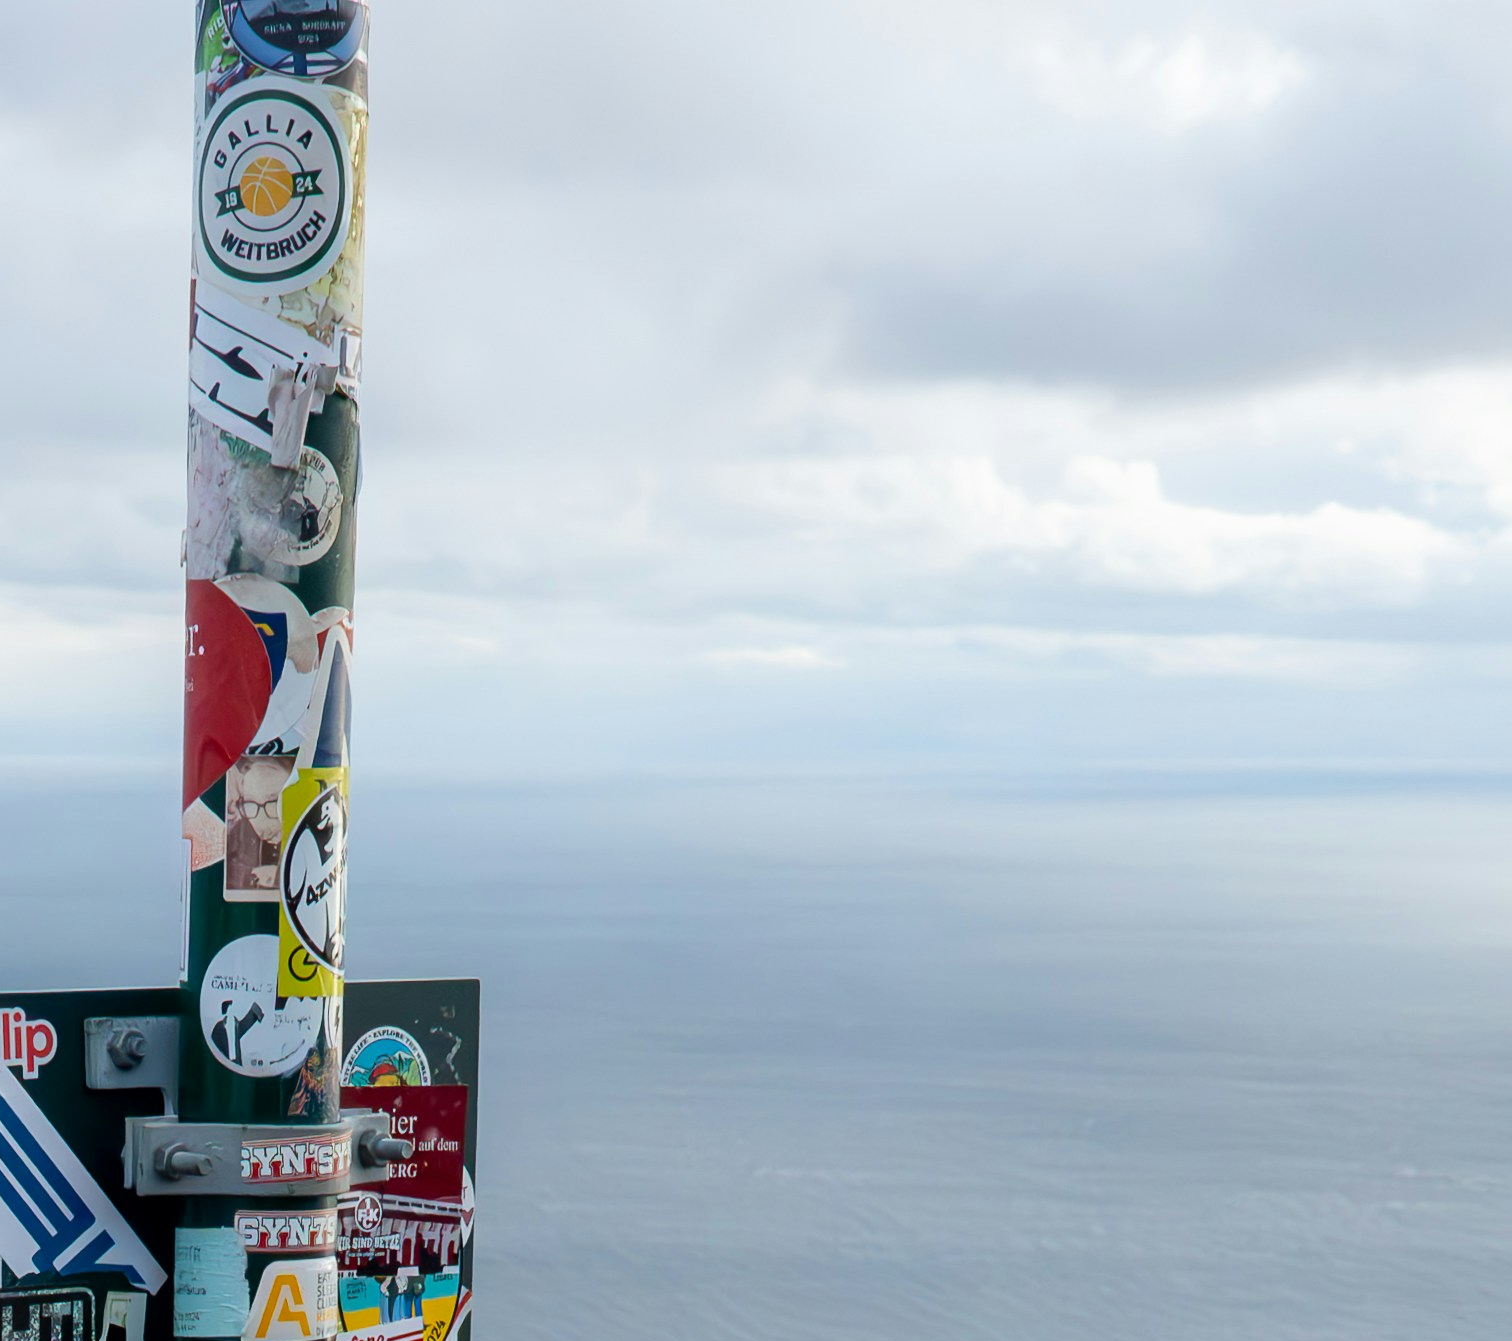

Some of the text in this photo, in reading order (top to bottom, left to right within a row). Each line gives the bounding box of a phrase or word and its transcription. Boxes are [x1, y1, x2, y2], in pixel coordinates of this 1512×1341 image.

[214, 114, 314, 169] GALLIA
[224, 176, 314, 208] 19 24
[219, 209, 327, 262] WEITBRUCH
[418, 1138, 437, 1151] auf
[437, 1138, 459, 1151] dem
[352, 1237, 373, 1250] SIND
